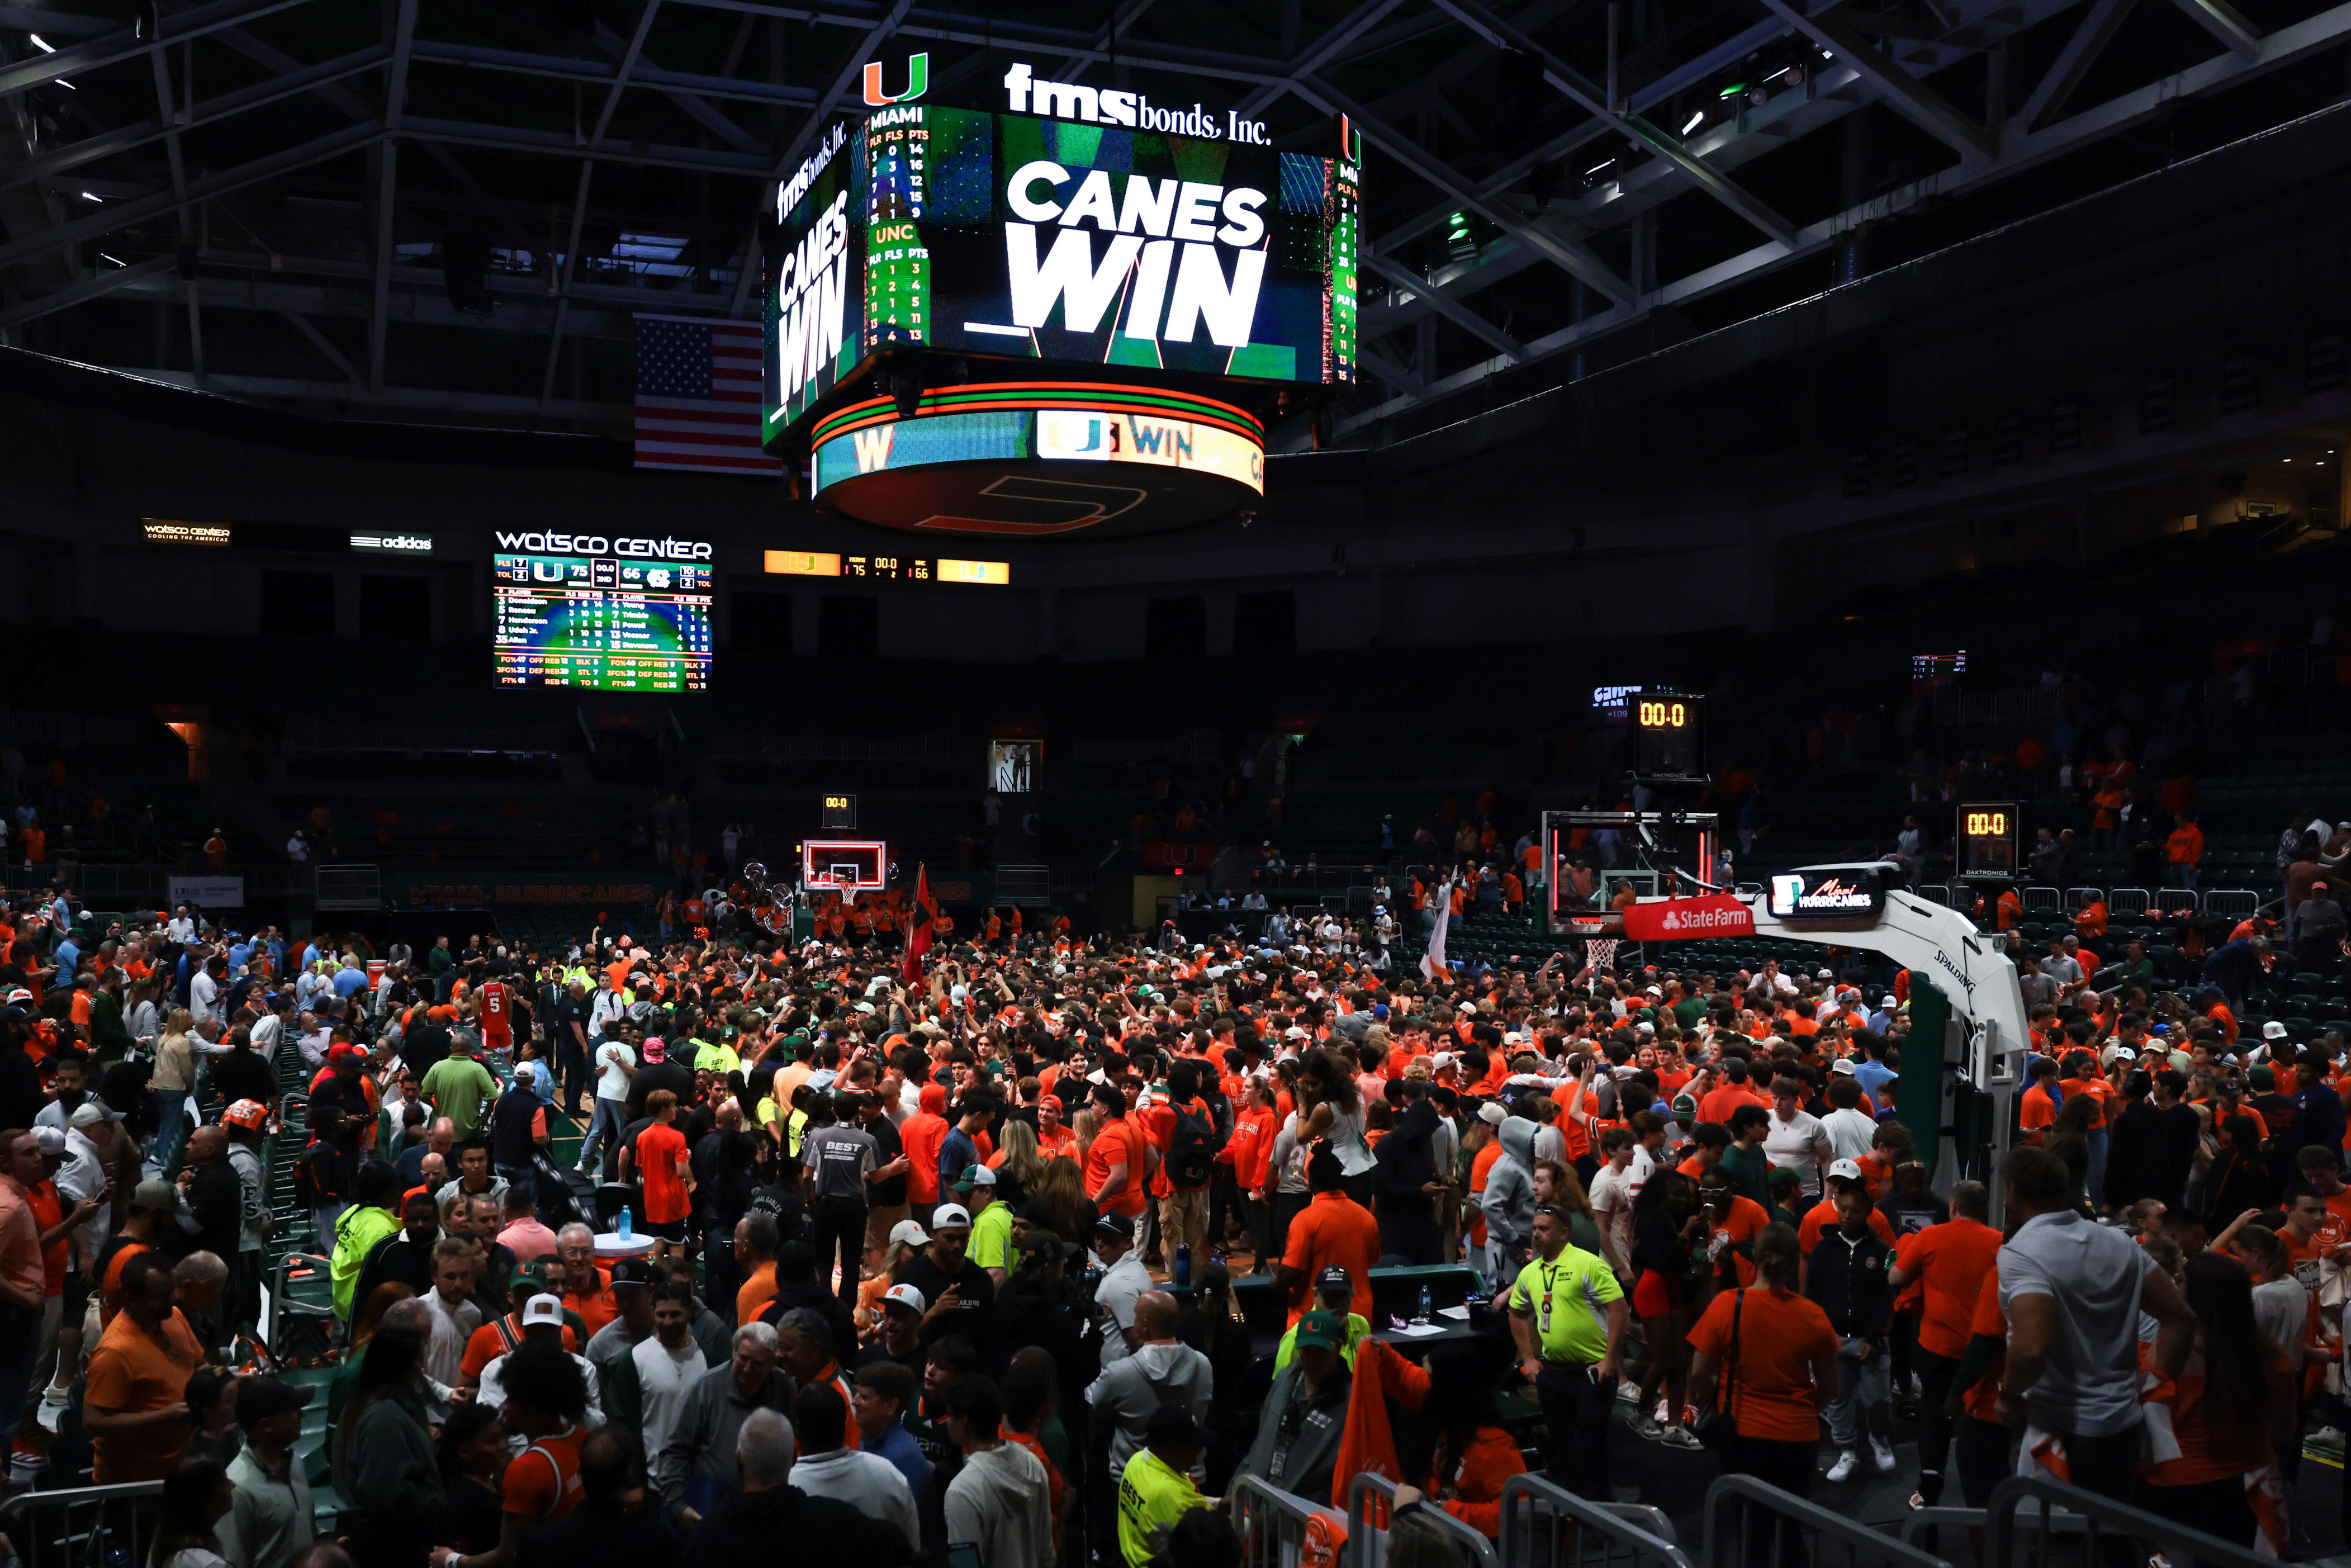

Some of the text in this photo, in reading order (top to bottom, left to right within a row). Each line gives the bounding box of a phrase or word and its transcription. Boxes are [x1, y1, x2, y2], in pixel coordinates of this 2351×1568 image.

[864, 52, 928, 106] U
[871, 107, 922, 131] MIAMI
[1228, 113, 1272, 146] Inc.
[832, 121, 846, 155] Inc.
[870, 130, 929, 148] PLR FLS PTS
[1342, 112, 1362, 170] U
[889, 144, 923, 156] 0 14
[889, 159, 923, 172] 3 16
[890, 176, 922, 188] 1 12
[1338, 183, 1351, 195] PLR
[890, 191, 922, 203] 1 15
[1006, 159, 1268, 247] CANES
[890, 207, 920, 219] 1 9
[876, 224, 913, 244] UNC
[780, 189, 848, 312] CANES
[869, 248, 928, 266] PLR FLS PTS
[890, 263, 919, 274] 1 3
[889, 280, 920, 292] 2 4
[1006, 220, 1268, 348] WIN
[890, 296, 919, 307] 1 5
[1336, 293, 1350, 306] PLR
[888, 313, 921, 324] 4 11
[778, 247, 848, 405] WIN
[888, 330, 922, 341] 4 13
[855, 424, 893, 472] W
[382, 536, 432, 550] adidas
[875, 557, 897, 569] 00.0
[534, 562, 563, 581] U
[571, 565, 587, 576] 75
[623, 568, 641, 579] 66
[853, 565, 865, 576] 75
[916, 567, 928, 579] 66
[498, 596, 505, 605] 3
[499, 605, 505, 614] 5
[612, 610, 619, 619] 7
[499, 625, 506, 634] 8
[496, 635, 508, 643] 35
[1641, 703, 1684, 726] 00.0
[826, 797, 847, 808] 00.0
[1968, 814, 2004, 834] 00.0
[1809, 878, 1856, 896] Miami
[497, 885, 655, 904] HURRICANES
[1799, 894, 1871, 908] HURRICANES
[1935, 950, 1976, 994] SPALDING
[490, 997, 500, 1012] 5
[826, 1141, 861, 1152] BEST
[765, 1196, 783, 1213] GABLES
[519, 1264, 535, 1275] U
[1306, 1320, 1321, 1332] U
[1121, 1478, 1145, 1511] BEST
